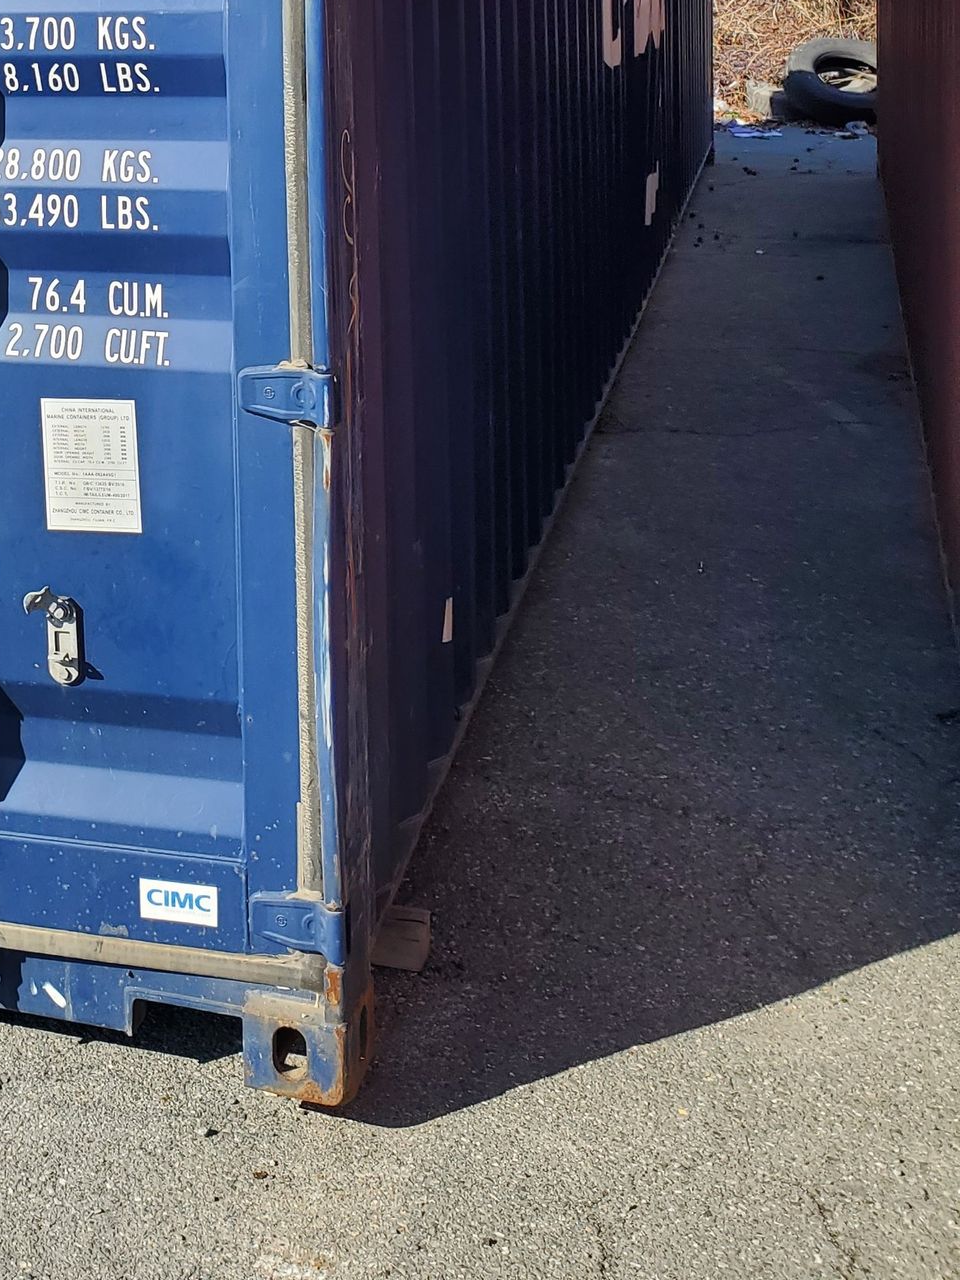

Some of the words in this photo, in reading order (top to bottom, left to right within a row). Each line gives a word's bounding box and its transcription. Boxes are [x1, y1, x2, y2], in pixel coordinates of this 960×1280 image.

[0, 16, 75, 50] 3,700
[97, 16, 155, 50] KGS.
[3, 62, 80, 92] 8,160
[99, 62, 160, 92] LBS.
[101, 149, 159, 183] KGS.
[101, 195, 158, 231] LBS.
[28, 276, 86, 313] 76.4
[108, 280, 169, 318] CU.M.
[5, 322, 83, 360] 2,700
[105, 328, 170, 366] CU.FT.
[147, 888, 211, 912] CIMC
